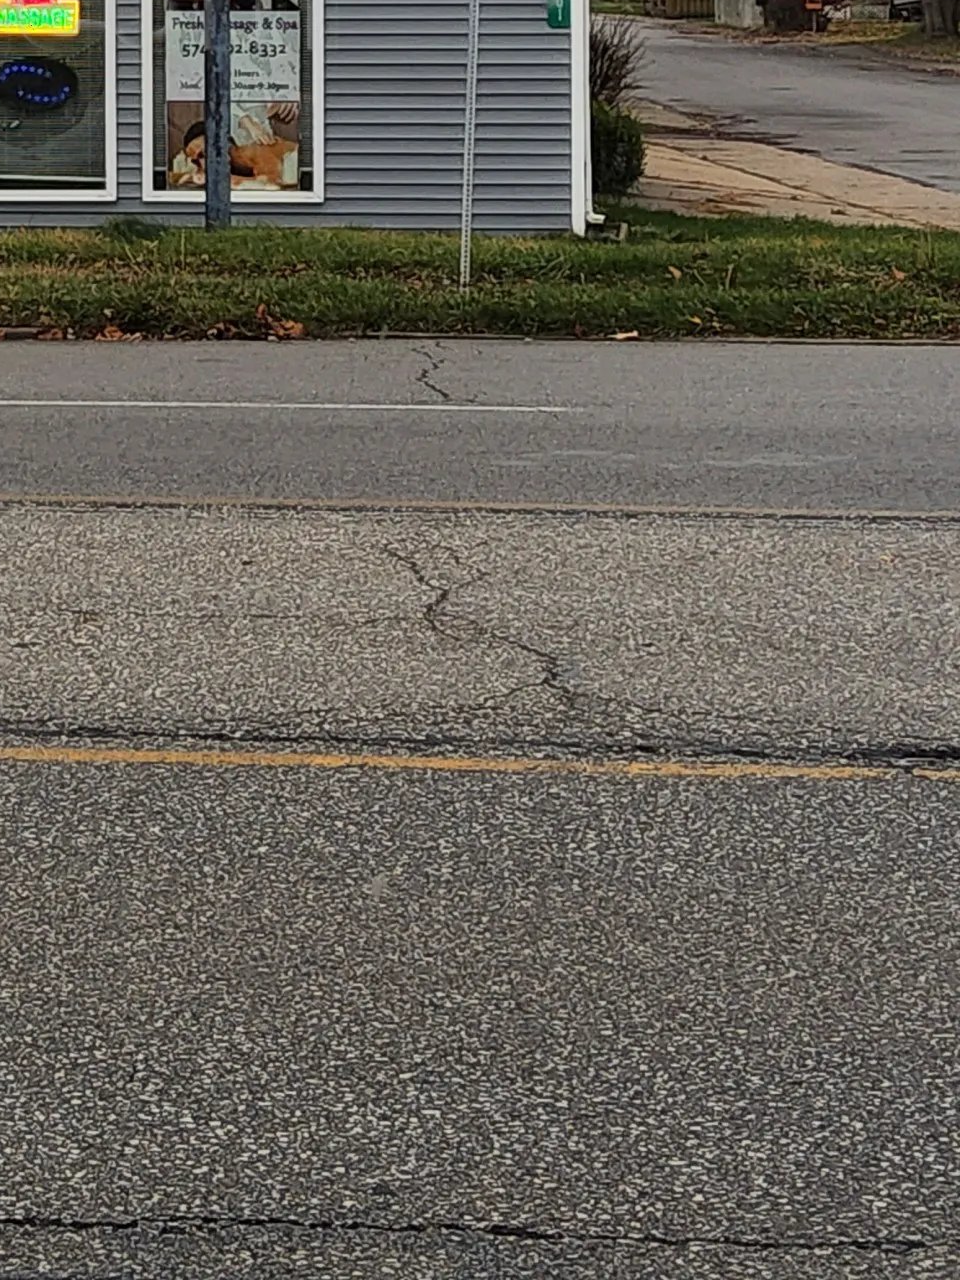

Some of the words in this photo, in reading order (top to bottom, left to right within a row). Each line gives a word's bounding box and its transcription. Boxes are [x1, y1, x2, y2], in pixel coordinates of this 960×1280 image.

[172, 16, 205, 30] Fresh
[262, 16, 274, 30] &
[275, 16, 298, 35] Spa
